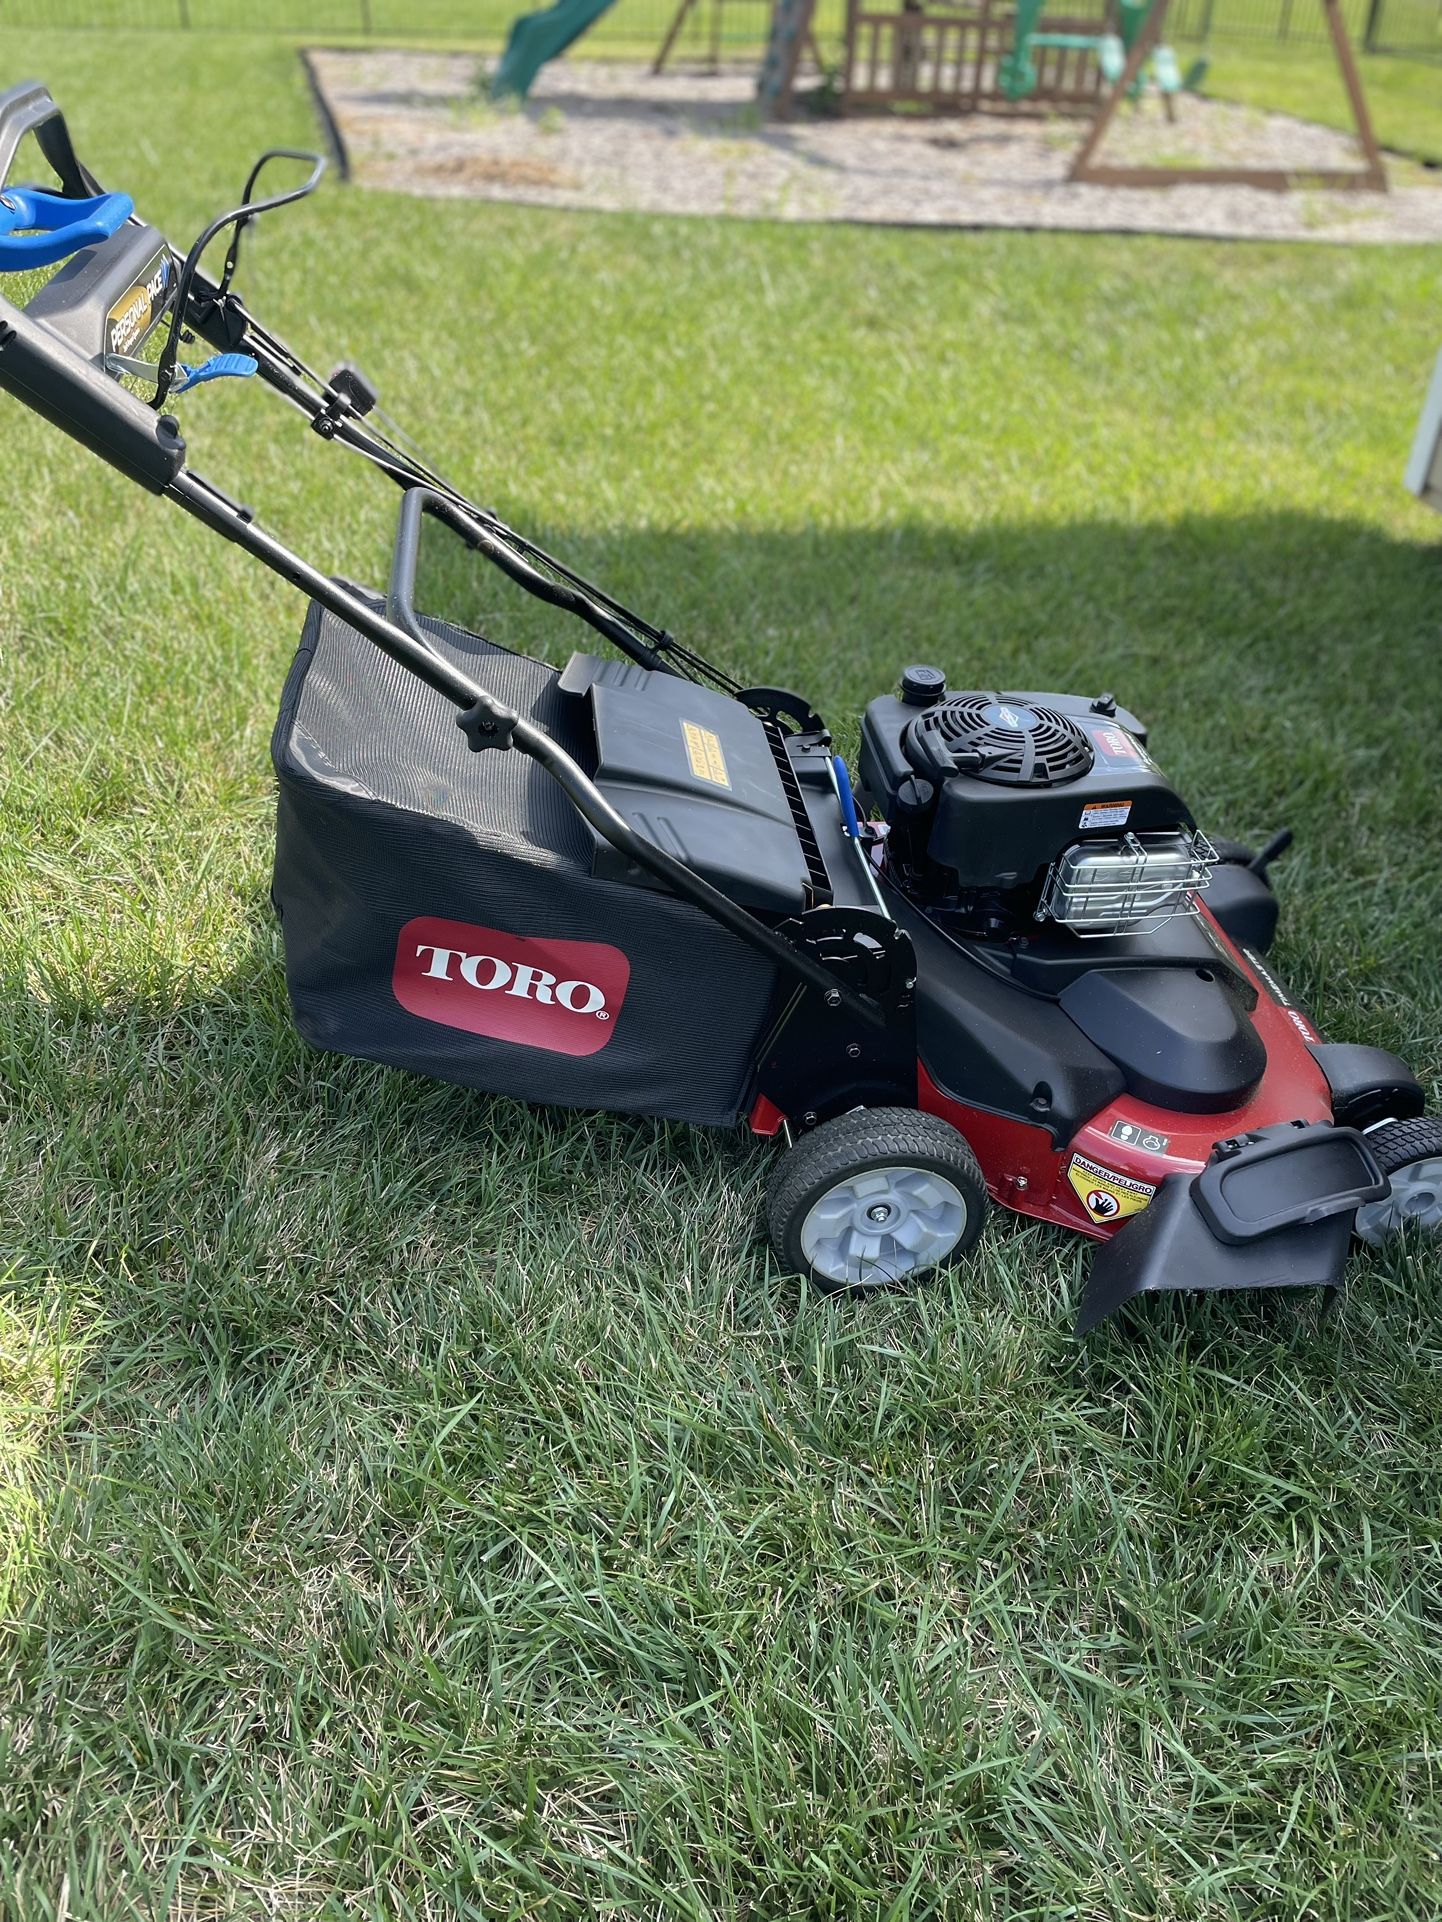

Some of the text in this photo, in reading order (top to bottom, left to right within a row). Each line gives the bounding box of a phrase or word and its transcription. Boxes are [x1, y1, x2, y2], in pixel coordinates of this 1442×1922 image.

[111, 292, 148, 352] PERSONAL
[146, 269, 163, 300] PACE
[1103, 731, 1127, 755] TORO
[1287, 1011, 1315, 1043] TORO
